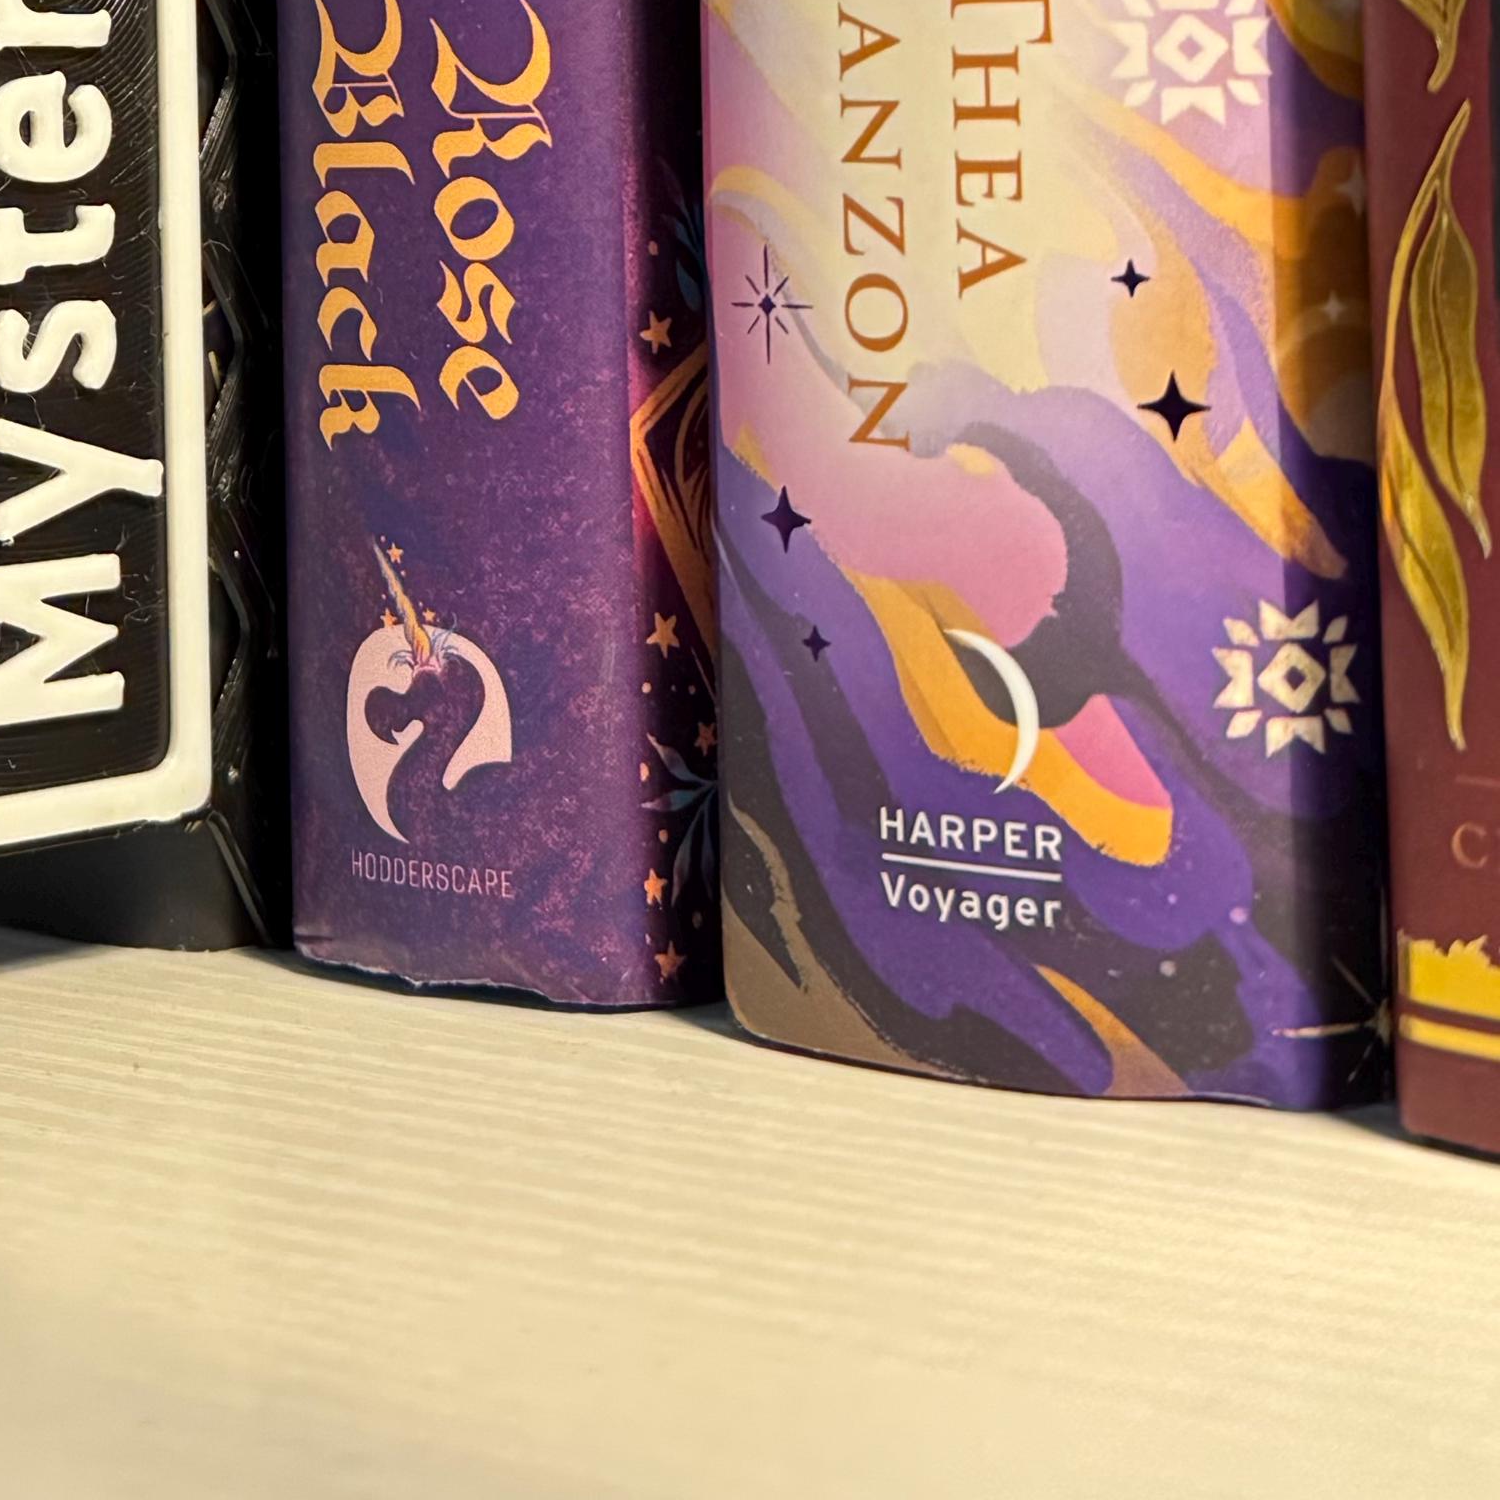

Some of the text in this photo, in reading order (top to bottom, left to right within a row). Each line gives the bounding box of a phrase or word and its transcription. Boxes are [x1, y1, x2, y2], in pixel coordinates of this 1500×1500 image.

[879, 805, 1063, 863] HARPER
[351, 848, 516, 900] HODDERSCAPE
[880, 870, 1063, 931] Voyager
